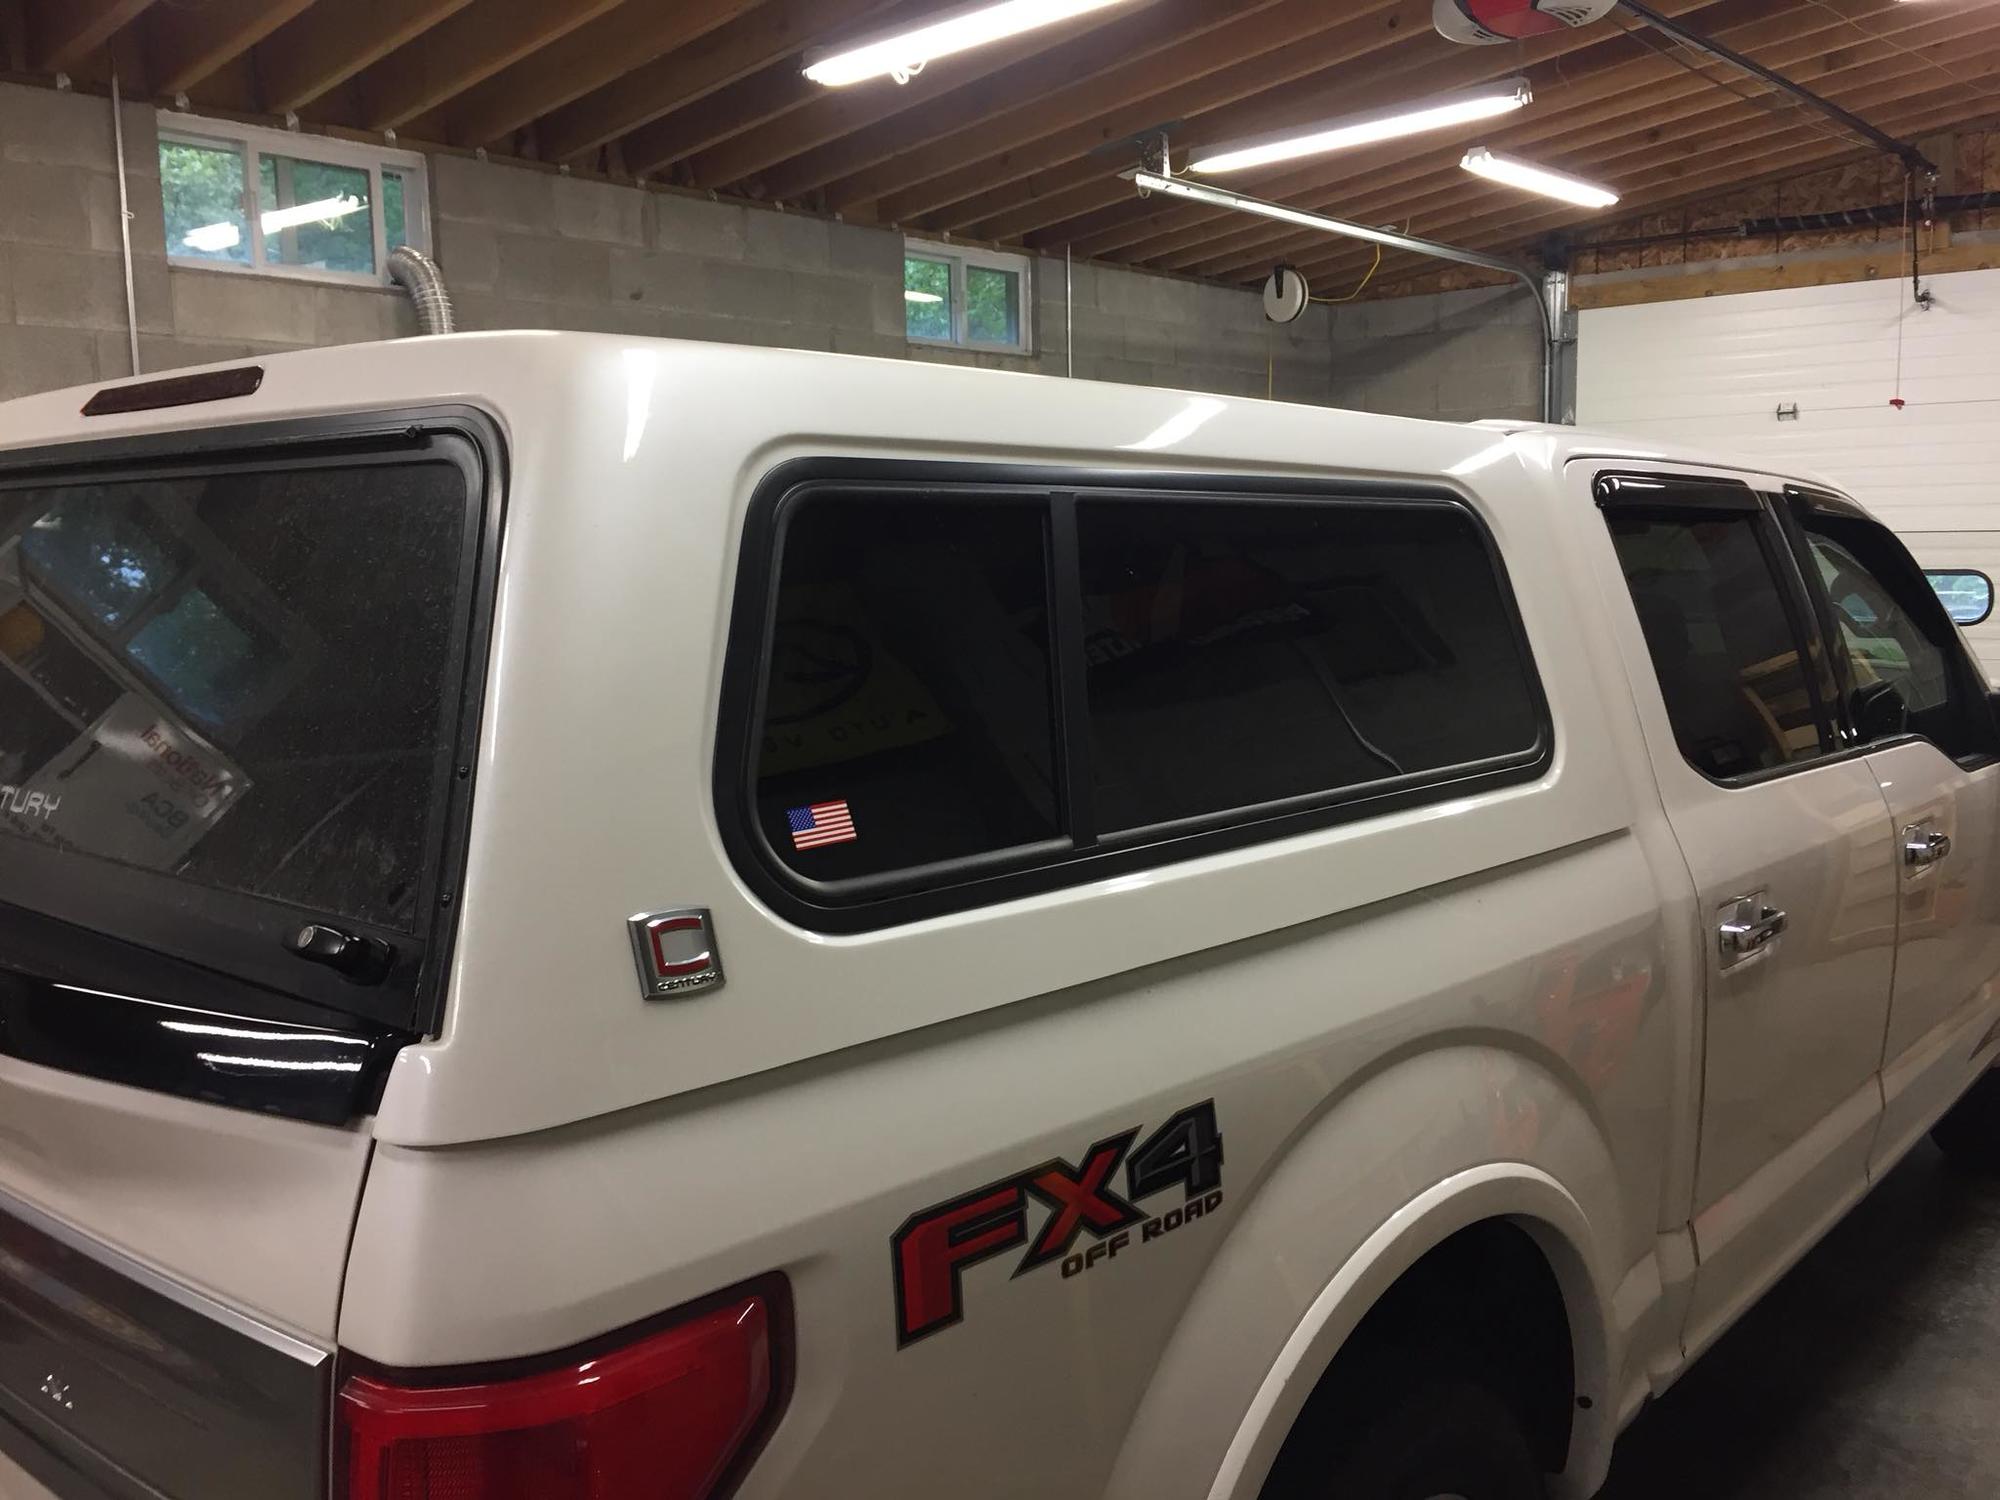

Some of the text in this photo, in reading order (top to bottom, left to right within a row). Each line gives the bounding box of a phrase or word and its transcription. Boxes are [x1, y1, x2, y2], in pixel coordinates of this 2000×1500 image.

[890, 1097, 1224, 1351] FX4
[1061, 1190, 1224, 1279] OFF ROAD
